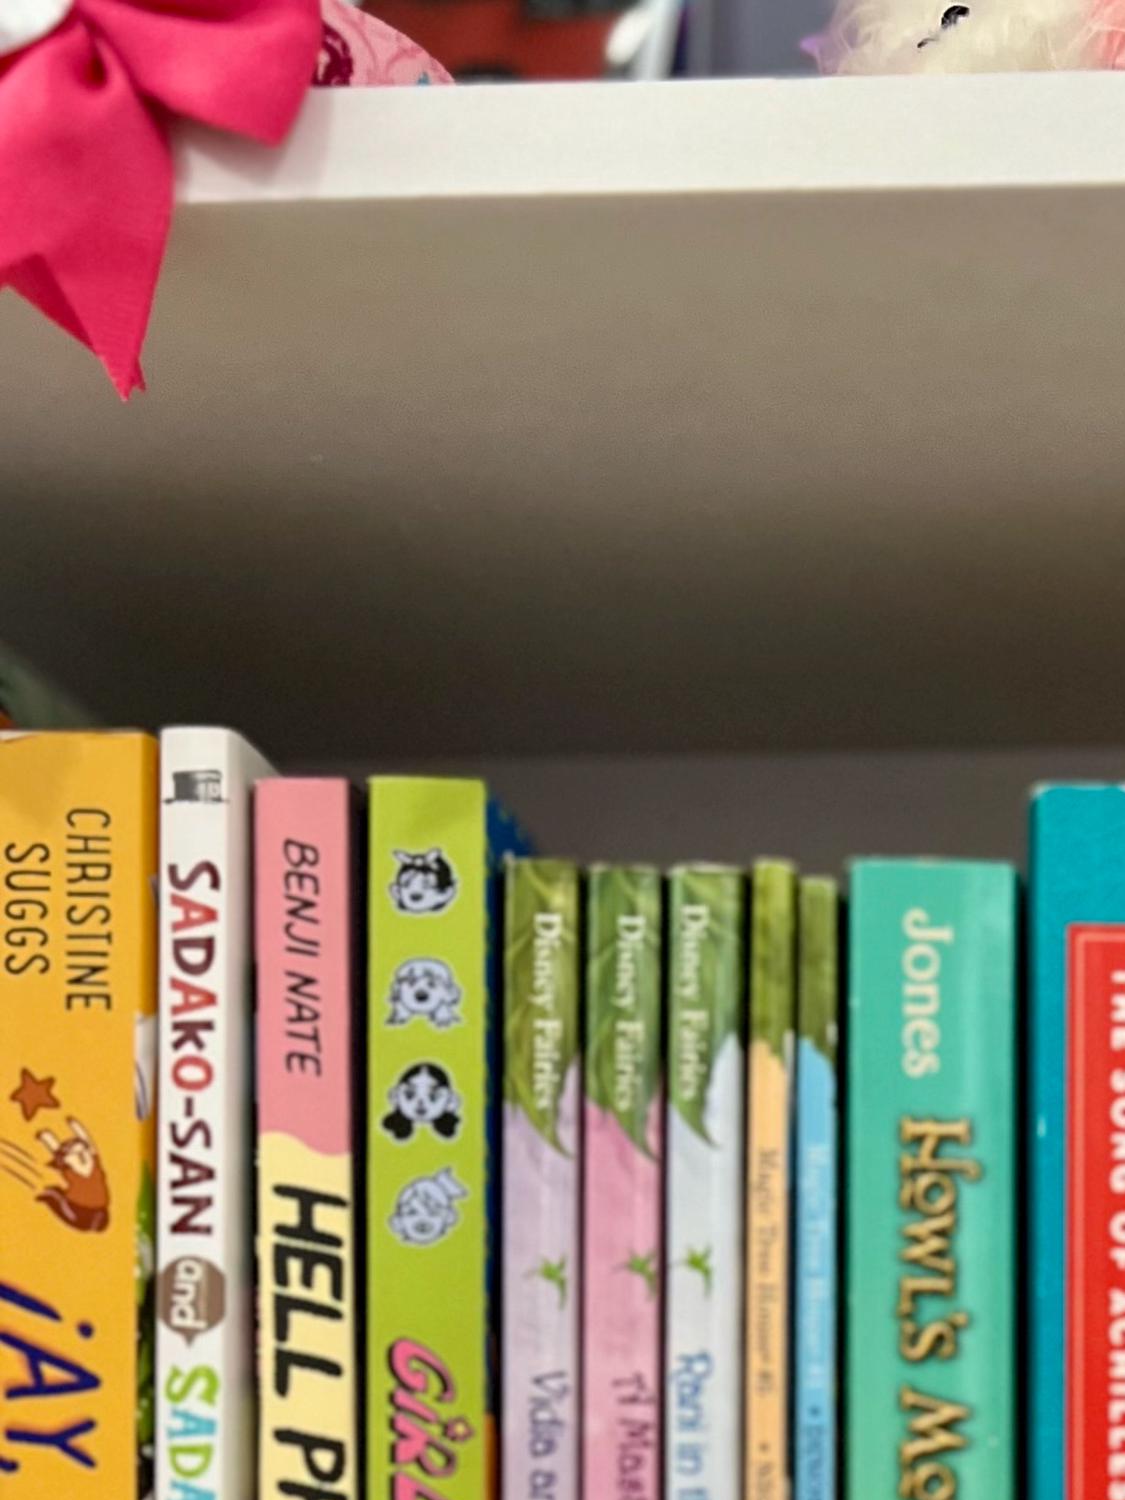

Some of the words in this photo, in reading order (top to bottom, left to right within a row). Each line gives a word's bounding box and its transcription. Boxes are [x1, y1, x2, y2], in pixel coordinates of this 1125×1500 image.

[4, 842, 50, 976] SUGGS
[65, 807, 113, 1012] CHRISTINE
[282, 837, 321, 958] BENJI
[533, 911, 562, 1011] Disney
[616, 913, 645, 1007] Disney
[679, 903, 709, 1000] Disney
[900, 908, 954, 1079] Jones
[284, 970, 323, 1077] NATE
[533, 1019, 563, 1109] Fairies
[617, 1019, 644, 1113] Fairies
[679, 1009, 707, 1100] Fairies
[897, 1115, 984, 1364] HOWL'S
[170, 1254, 208, 1336] and
[271, 1181, 348, 1400] HELL
[524, 1369, 569, 1458] Vidia
[670, 1350, 712, 1430] Rani
[677, 1441, 711, 1474] in
